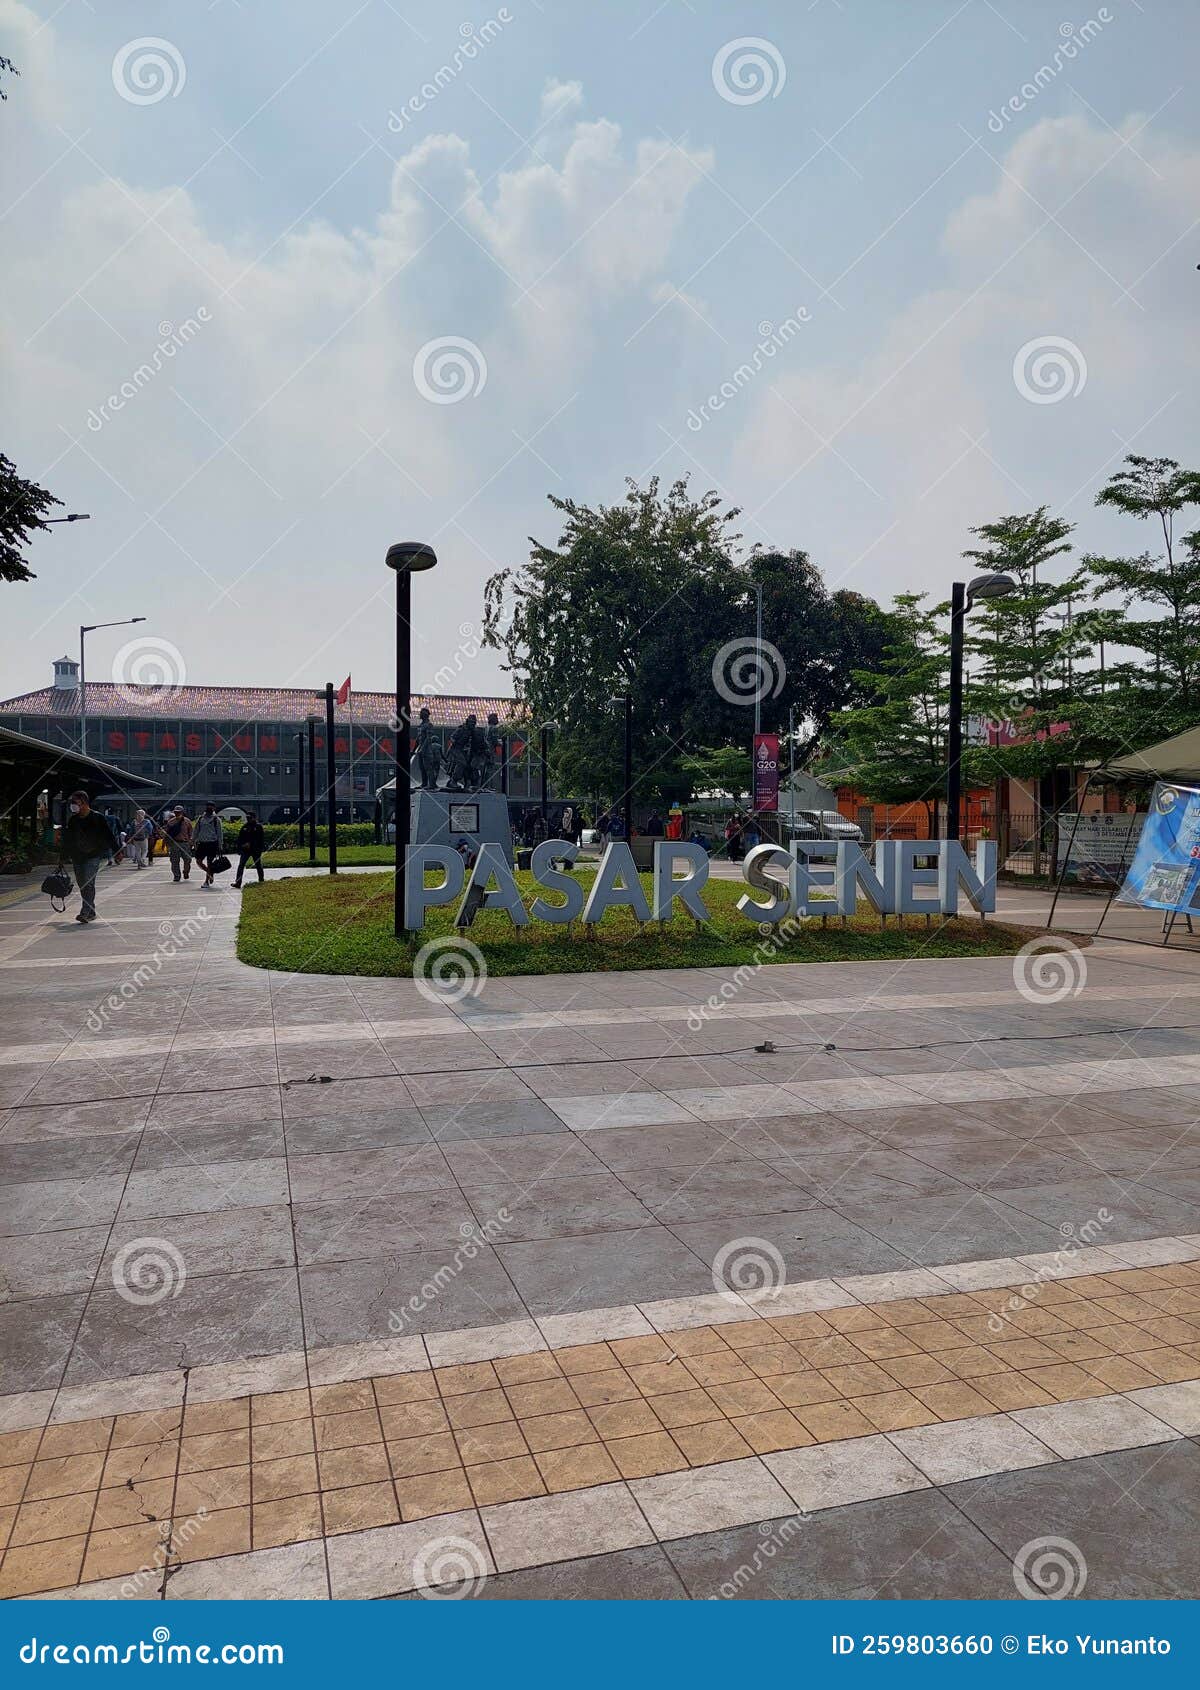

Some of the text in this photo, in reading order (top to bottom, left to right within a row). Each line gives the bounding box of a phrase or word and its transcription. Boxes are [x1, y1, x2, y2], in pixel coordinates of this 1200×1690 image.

[107, 731, 278, 752] STASIUN
[756, 760, 777, 769] G20
[404, 839, 997, 930] PASAR SENEN
